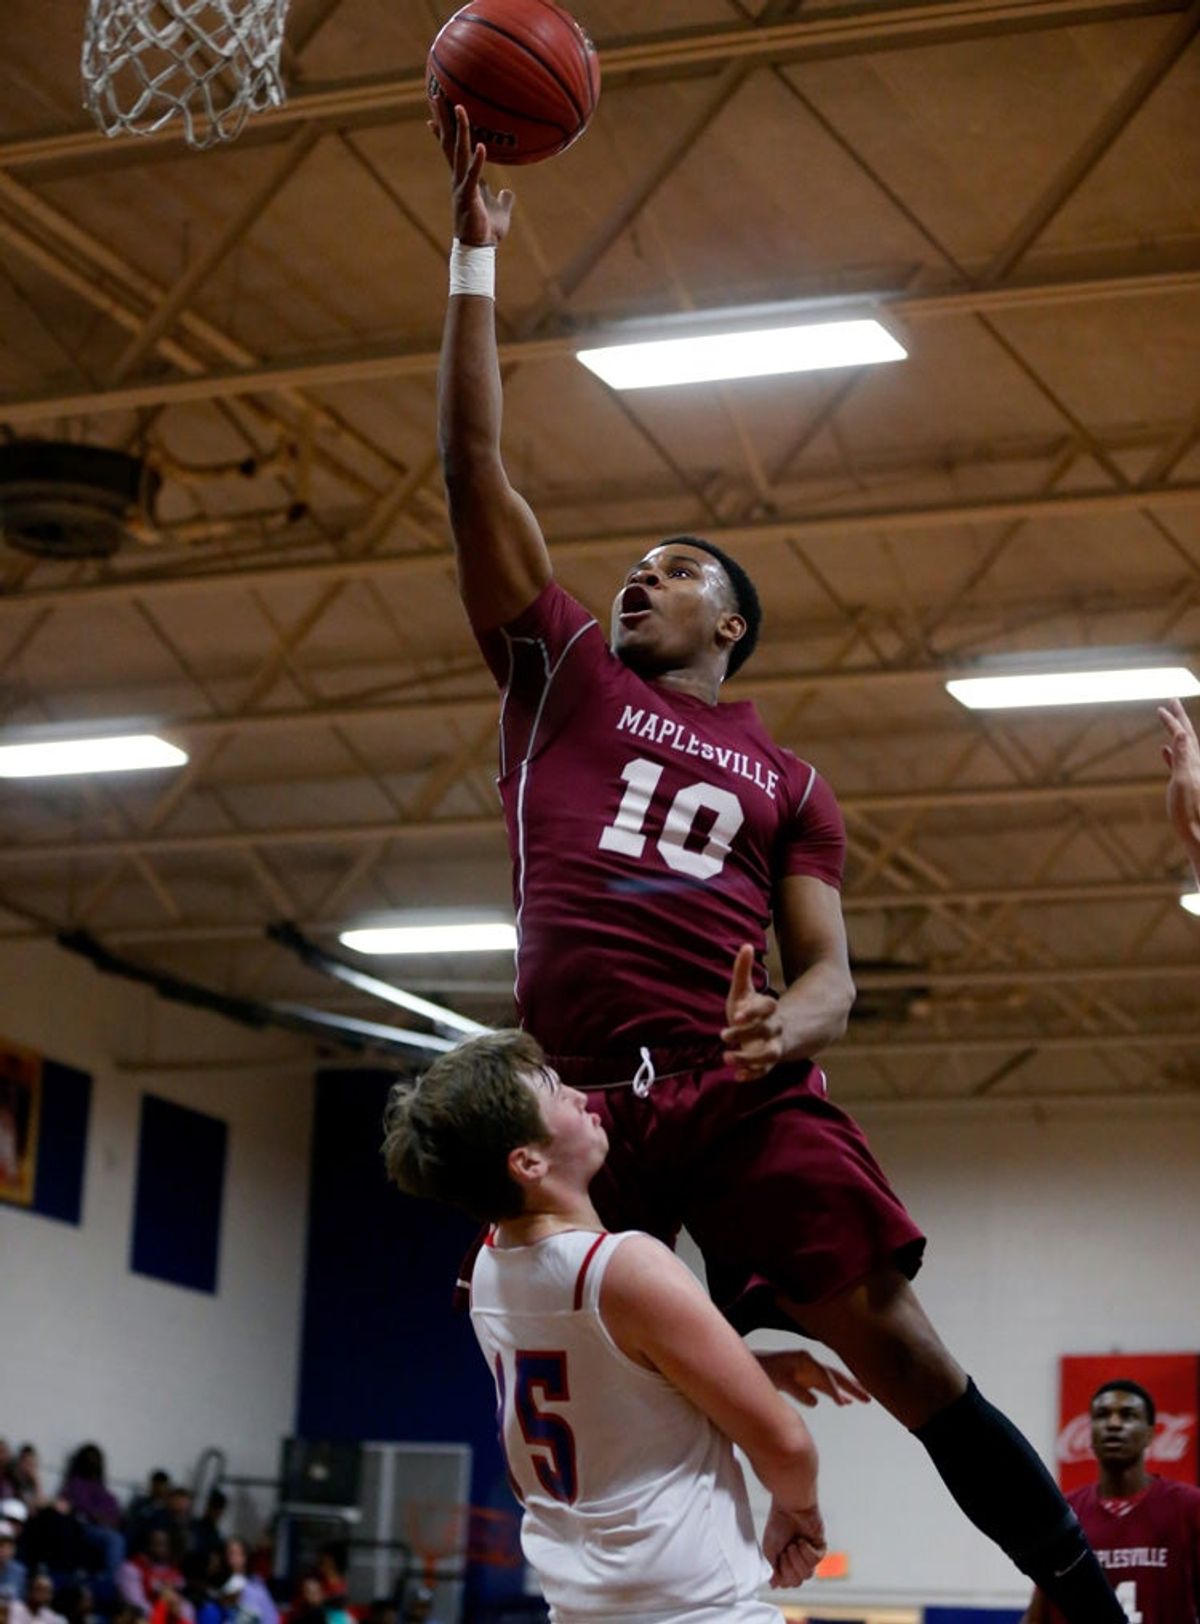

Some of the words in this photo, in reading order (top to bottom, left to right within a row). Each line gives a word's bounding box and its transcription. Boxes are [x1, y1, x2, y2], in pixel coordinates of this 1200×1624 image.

[616, 705, 779, 799] MAPLESVILLE
[598, 757, 745, 880] 10
[1096, 1548, 1168, 1569] PLESVILLE
